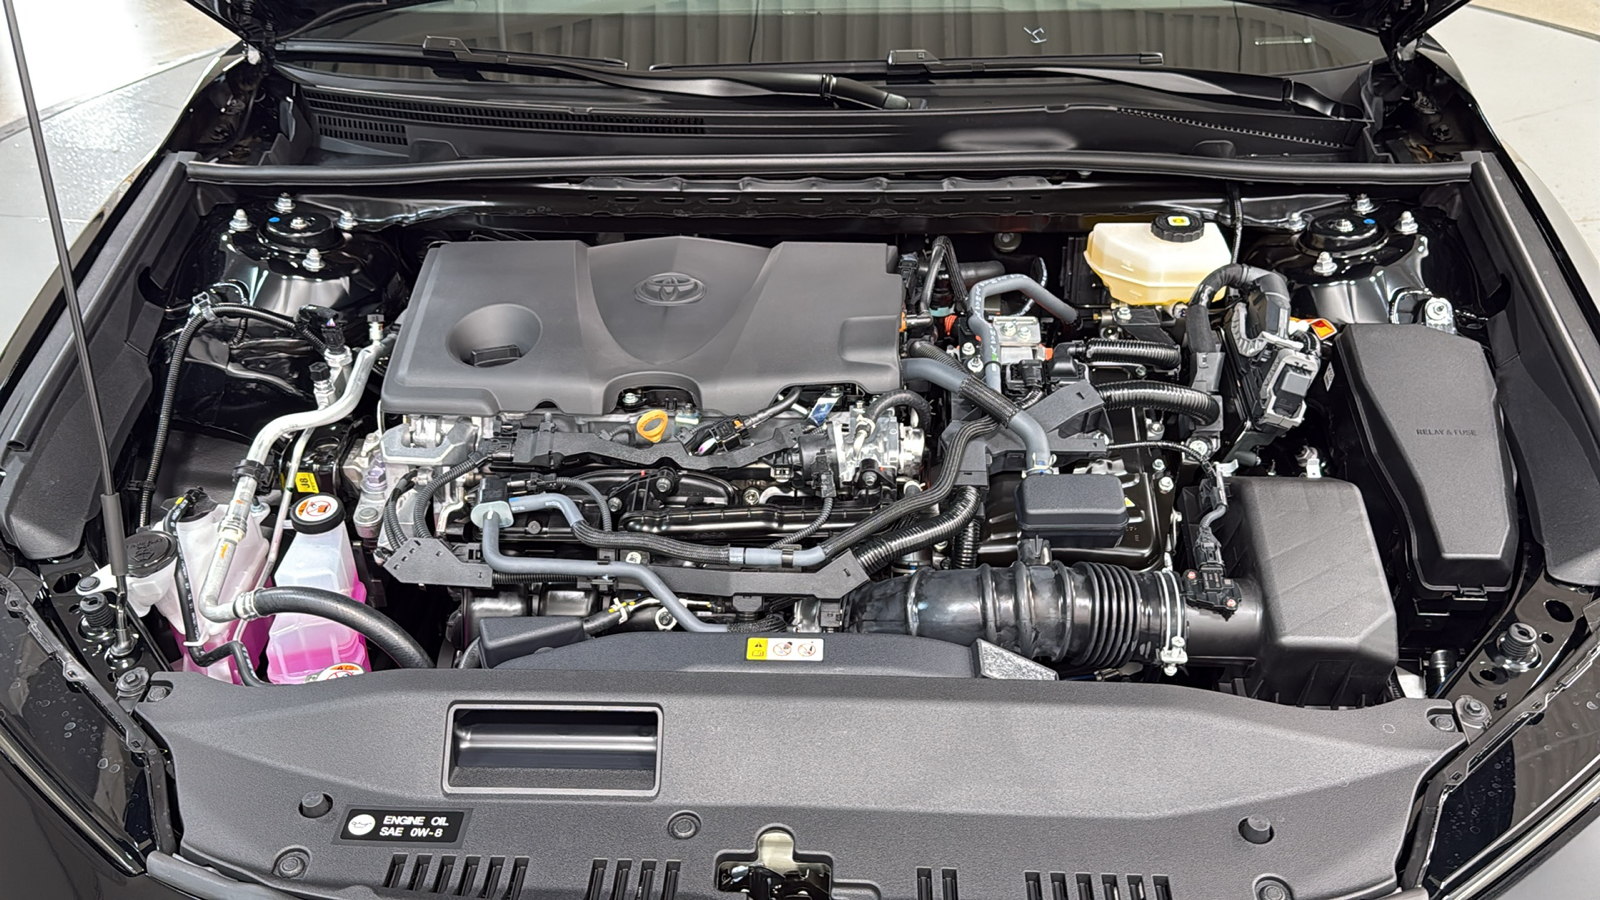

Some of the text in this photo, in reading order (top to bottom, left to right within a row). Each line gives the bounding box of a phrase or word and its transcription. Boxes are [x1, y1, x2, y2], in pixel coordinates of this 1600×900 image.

[1416, 428, 1444, 436] RELAY
[383, 815, 449, 826] ENGINE OIL
[379, 827, 404, 836] SAE
